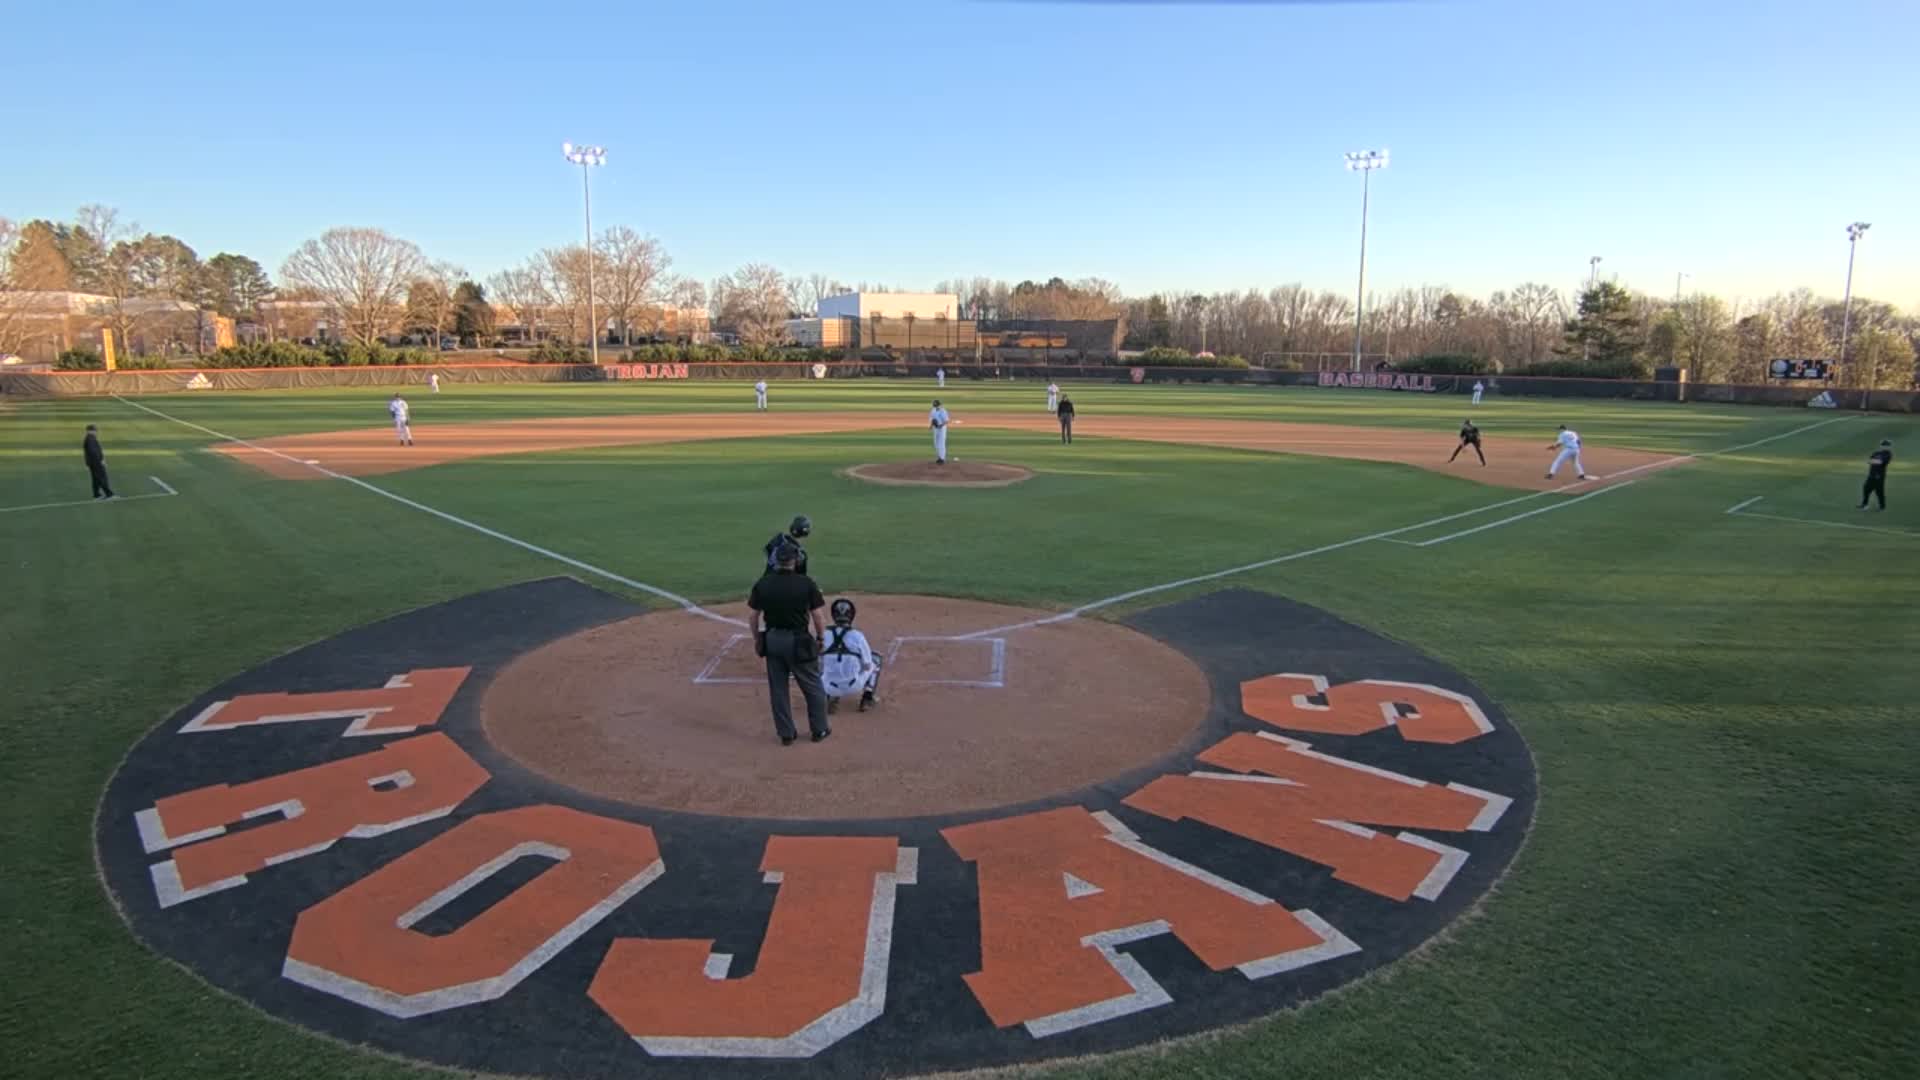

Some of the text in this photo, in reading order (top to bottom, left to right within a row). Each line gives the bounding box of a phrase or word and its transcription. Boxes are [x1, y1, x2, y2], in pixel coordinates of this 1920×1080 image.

[604, 364, 688, 378] TROJAN
[1319, 372, 1436, 391] BASEBALL
[134, 665, 1514, 1058] TROJANS
